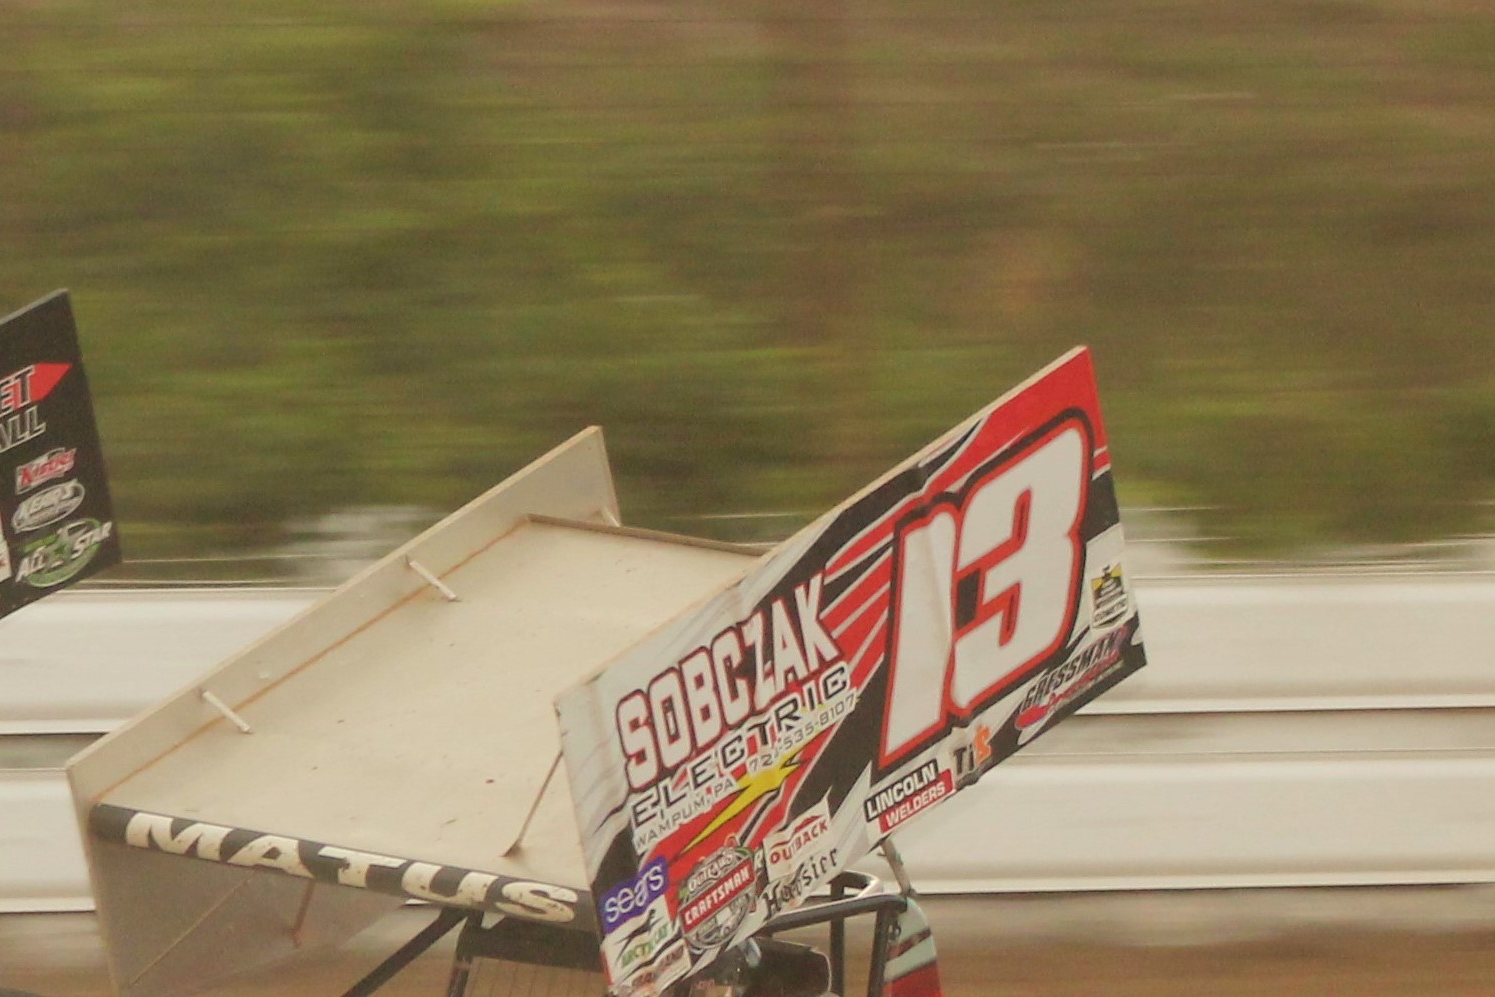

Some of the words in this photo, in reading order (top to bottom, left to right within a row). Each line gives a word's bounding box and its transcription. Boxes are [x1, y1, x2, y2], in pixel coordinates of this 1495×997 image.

[881, 424, 1086, 766] 13
[617, 573, 843, 790] SOBCZAK
[632, 666, 848, 828] ELECTRIC
[867, 763, 936, 820] LINCOLN
[885, 782, 946, 828] WELDERS
[126, 812, 579, 924] MATUS
[770, 819, 829, 866] OUBACK
[684, 865, 751, 927] CRAFTSMAN
